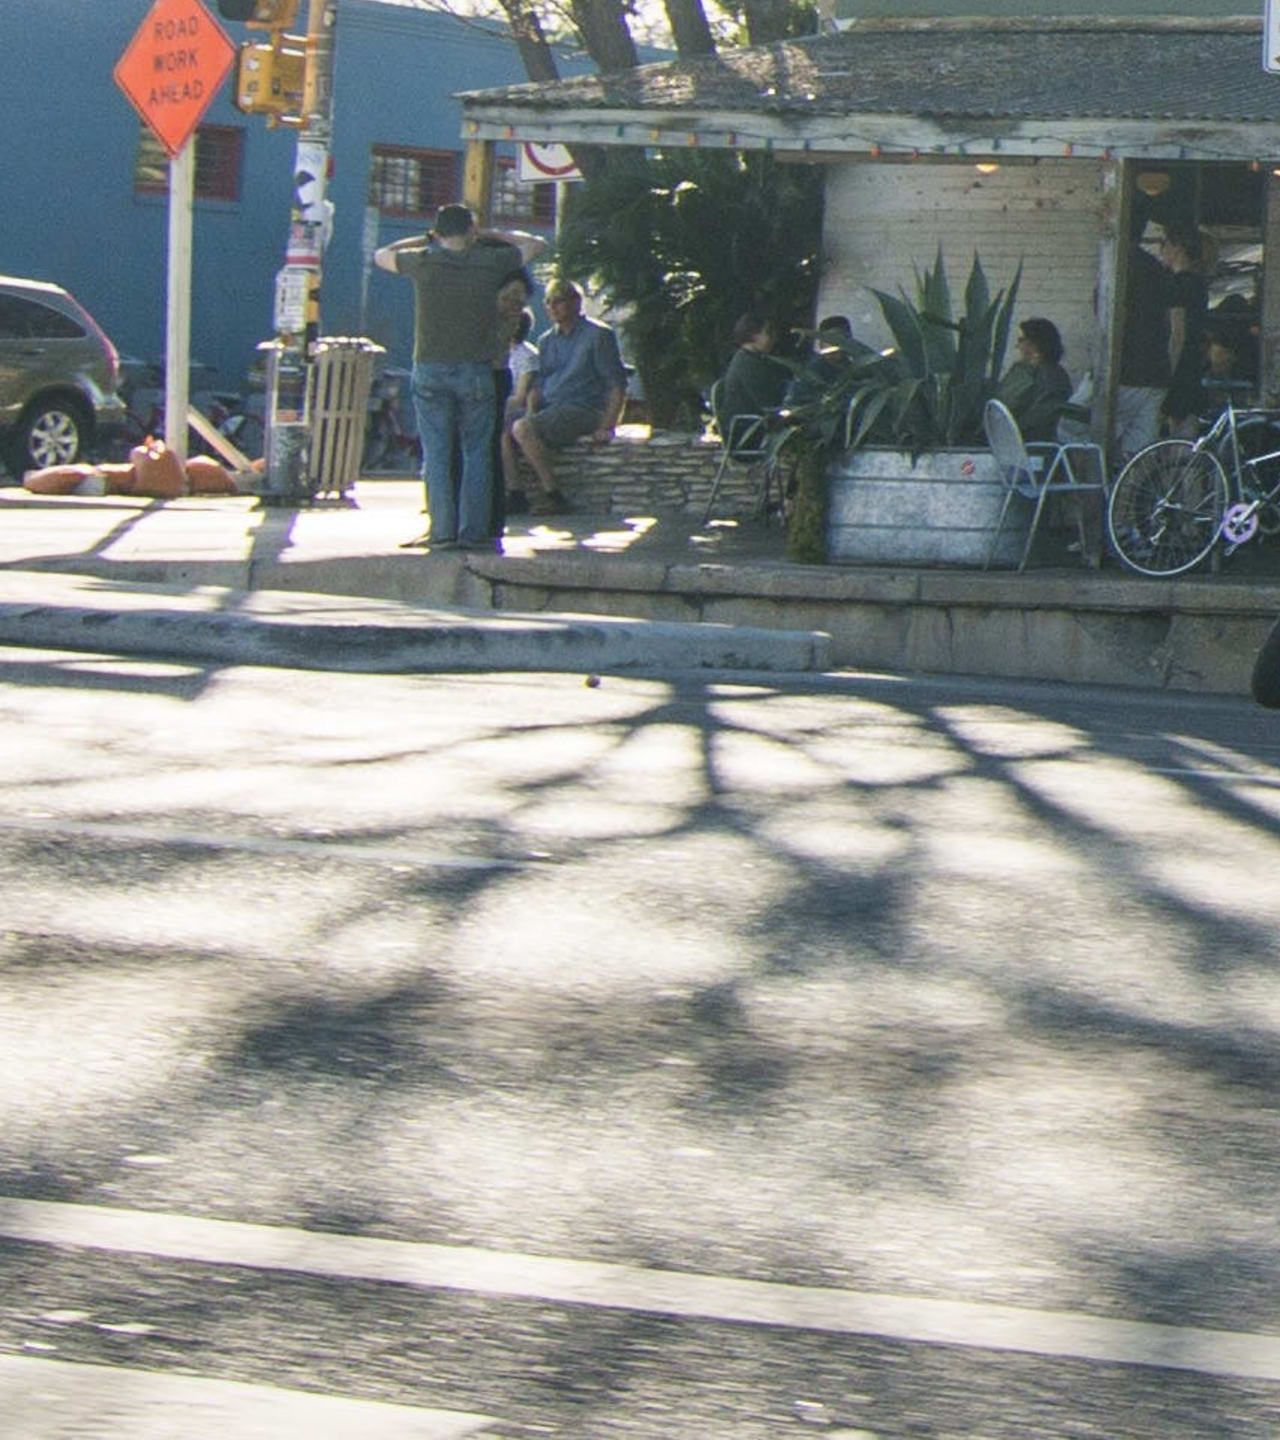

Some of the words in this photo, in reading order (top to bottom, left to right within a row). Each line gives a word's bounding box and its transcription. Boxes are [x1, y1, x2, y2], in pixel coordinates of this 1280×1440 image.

[154, 16, 199, 41] ROAD
[153, 49, 199, 73] WORK
[149, 80, 204, 106] AHEAD
